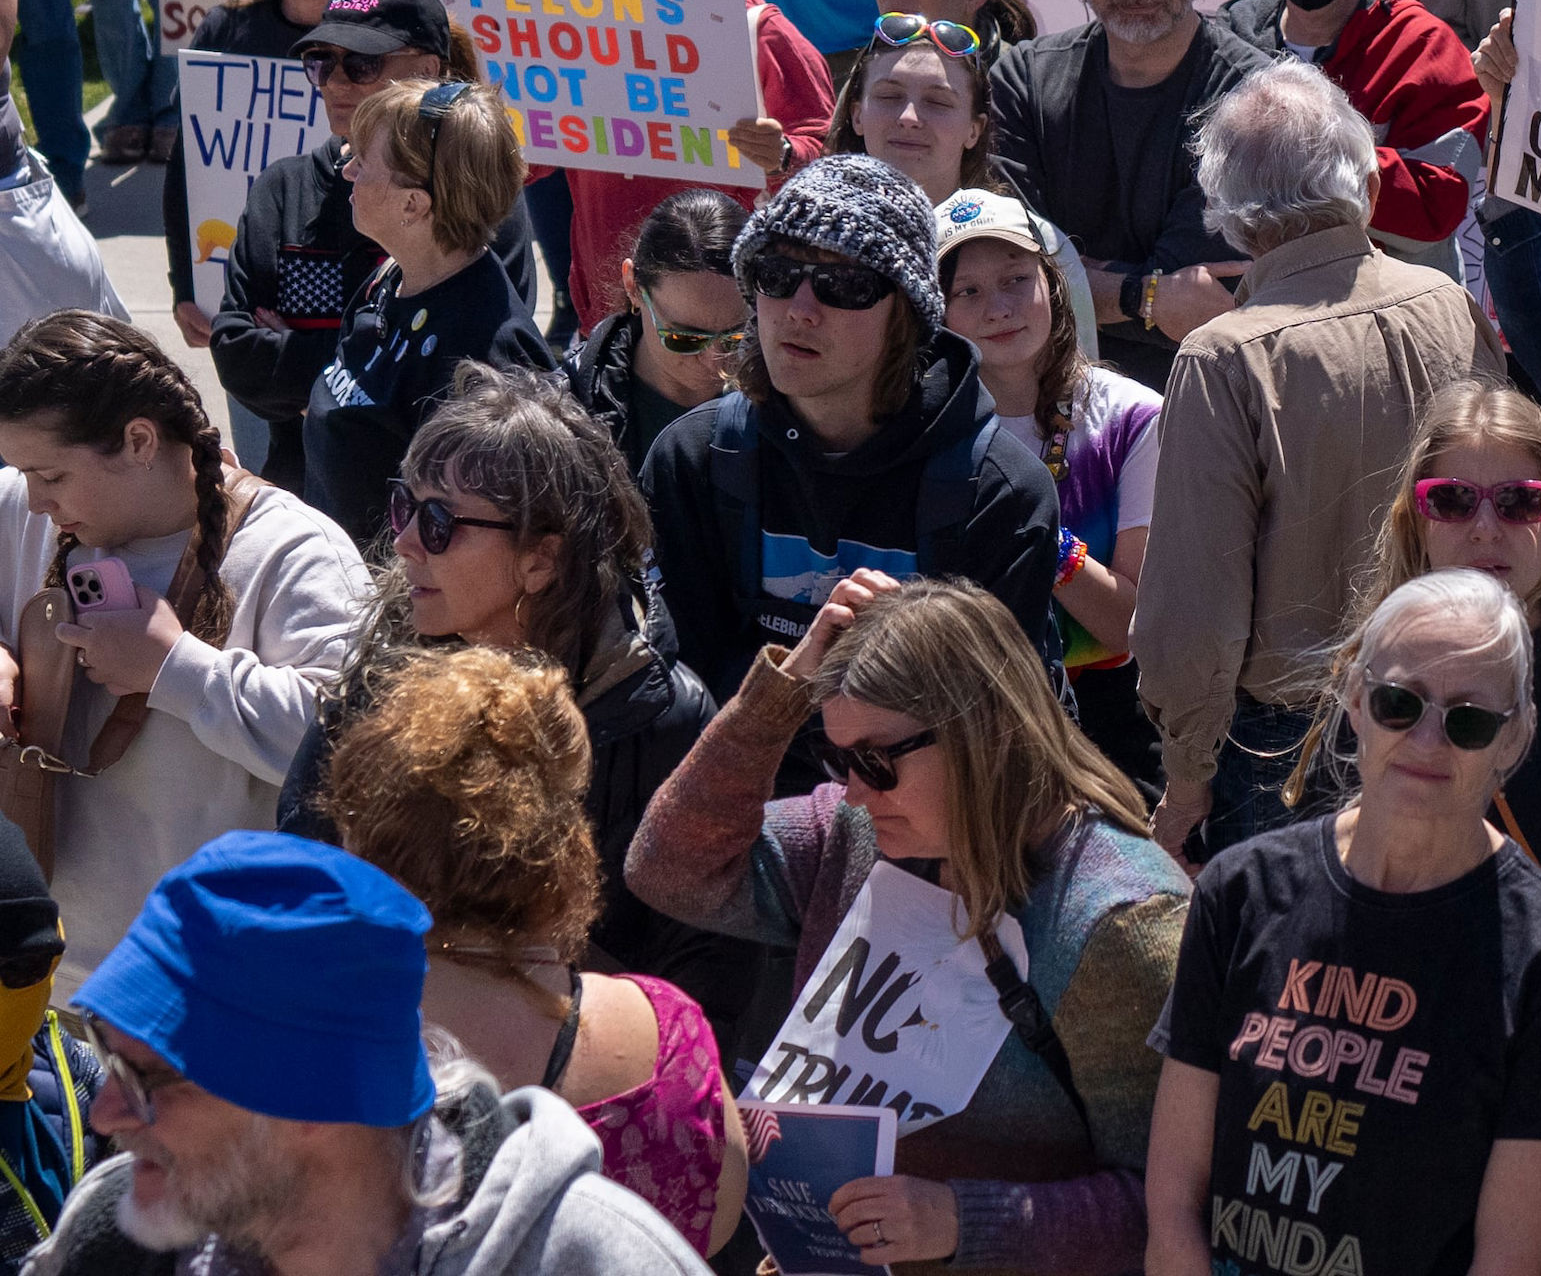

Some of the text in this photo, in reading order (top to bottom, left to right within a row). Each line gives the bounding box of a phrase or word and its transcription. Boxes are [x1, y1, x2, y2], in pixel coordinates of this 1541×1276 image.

[471, 14, 700, 74] SHOULD
[486, 59, 691, 118] NOT BE
[1277, 958, 1418, 1032] KIND
[1229, 1012, 1430, 1105] PEOPLE
[1247, 1081, 1366, 1157] ARE
[1246, 1142, 1344, 1214] MY
[1211, 1195, 1364, 1275] KINDA
